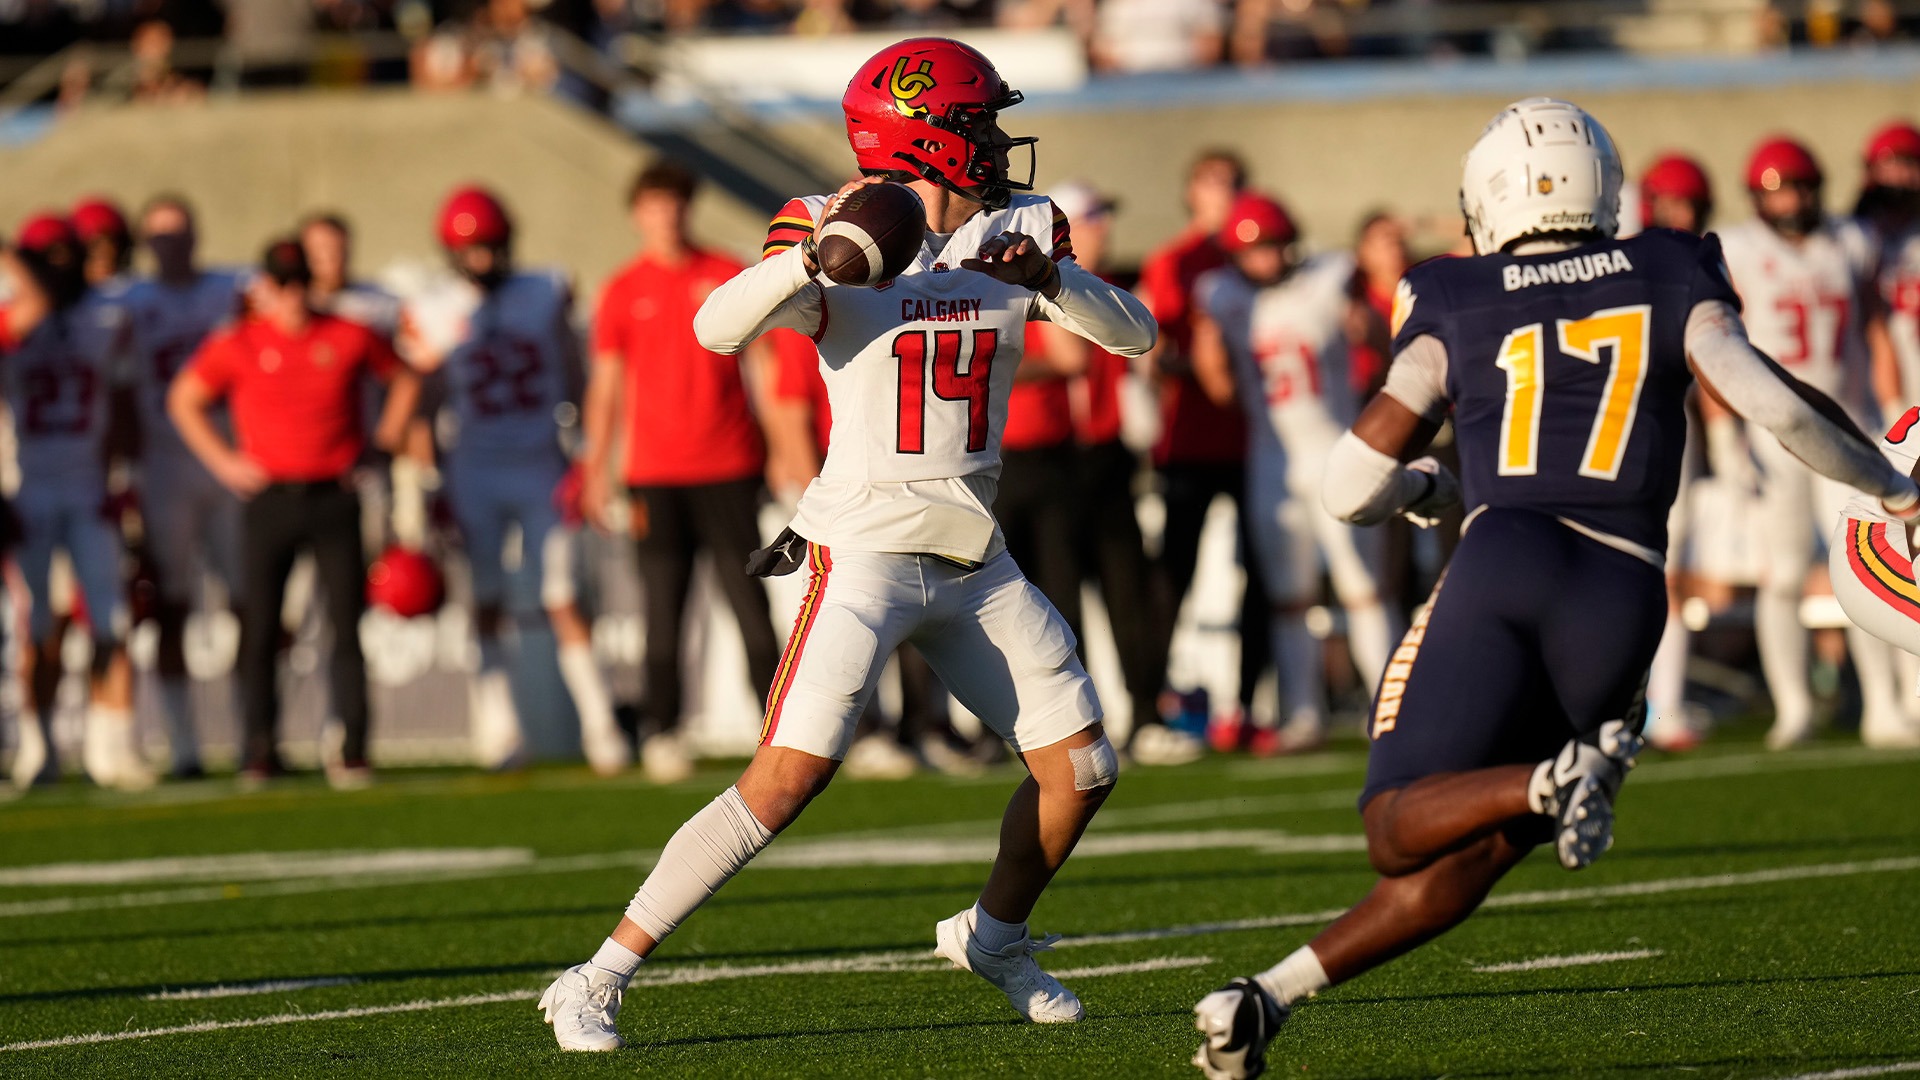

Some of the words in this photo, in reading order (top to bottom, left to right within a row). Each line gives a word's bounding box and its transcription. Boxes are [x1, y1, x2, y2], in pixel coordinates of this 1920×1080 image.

[1503, 249, 1633, 292] BANGURA
[901, 298, 982, 322] CALGARY
[1775, 294, 1851, 366] 37
[892, 328, 998, 454] 14
[1496, 304, 1651, 481] 17
